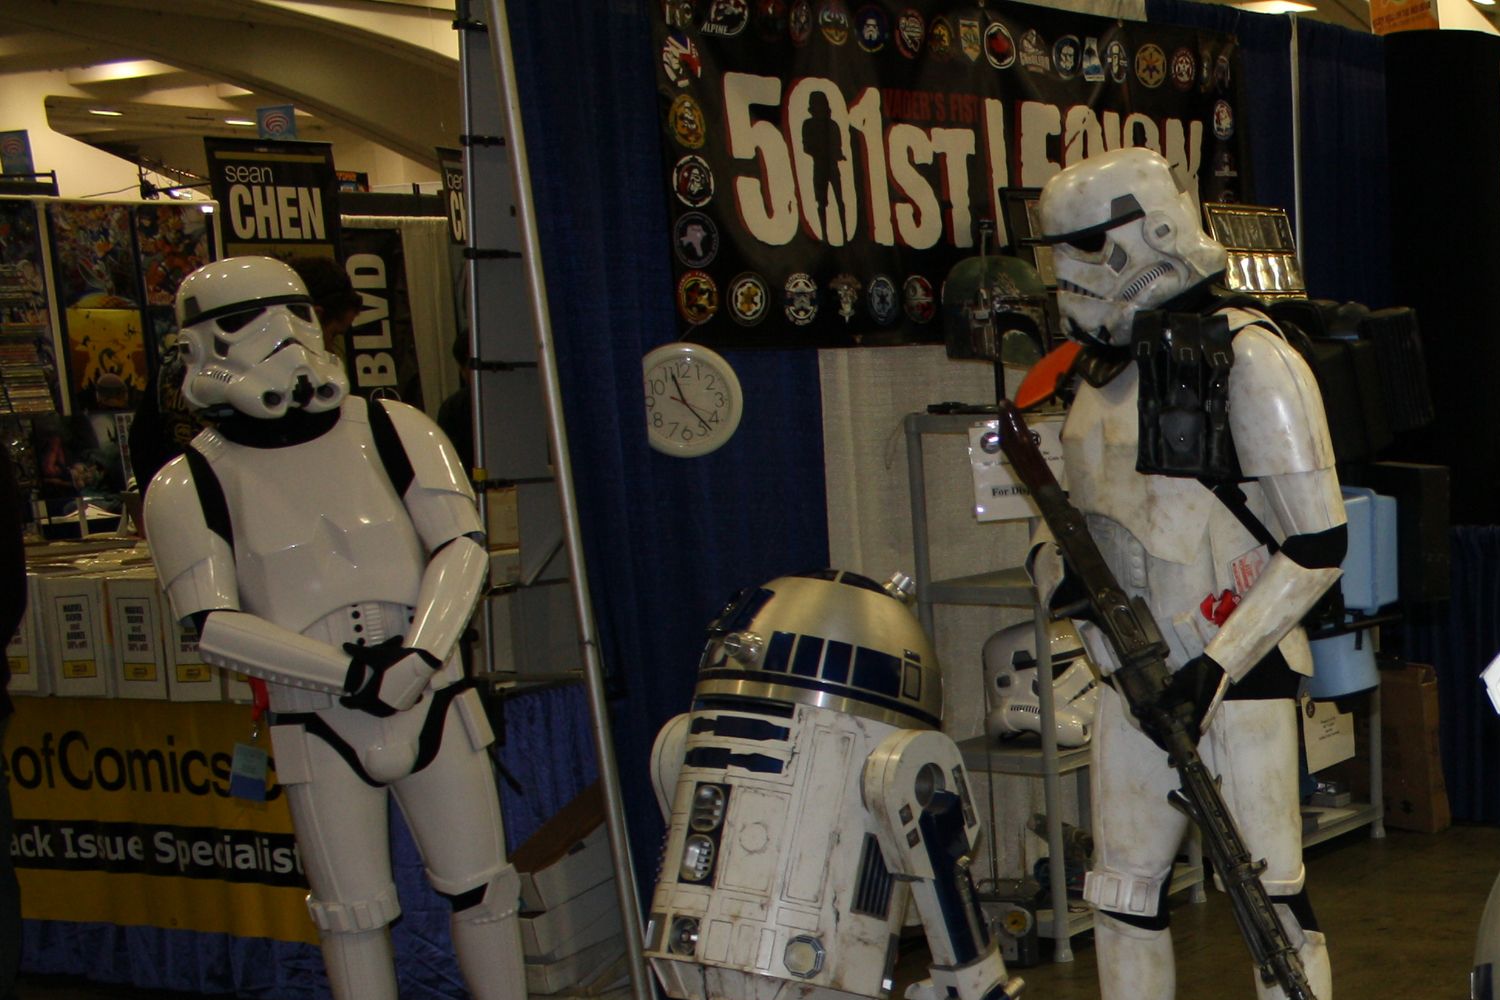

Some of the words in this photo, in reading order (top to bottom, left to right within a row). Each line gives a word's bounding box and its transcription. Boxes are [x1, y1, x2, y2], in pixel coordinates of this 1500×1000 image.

[224, 164, 274, 184] sean
[228, 184, 327, 240] CHEN
[992, 487, 1009, 497] For
[60, 827, 144, 862] Issue
